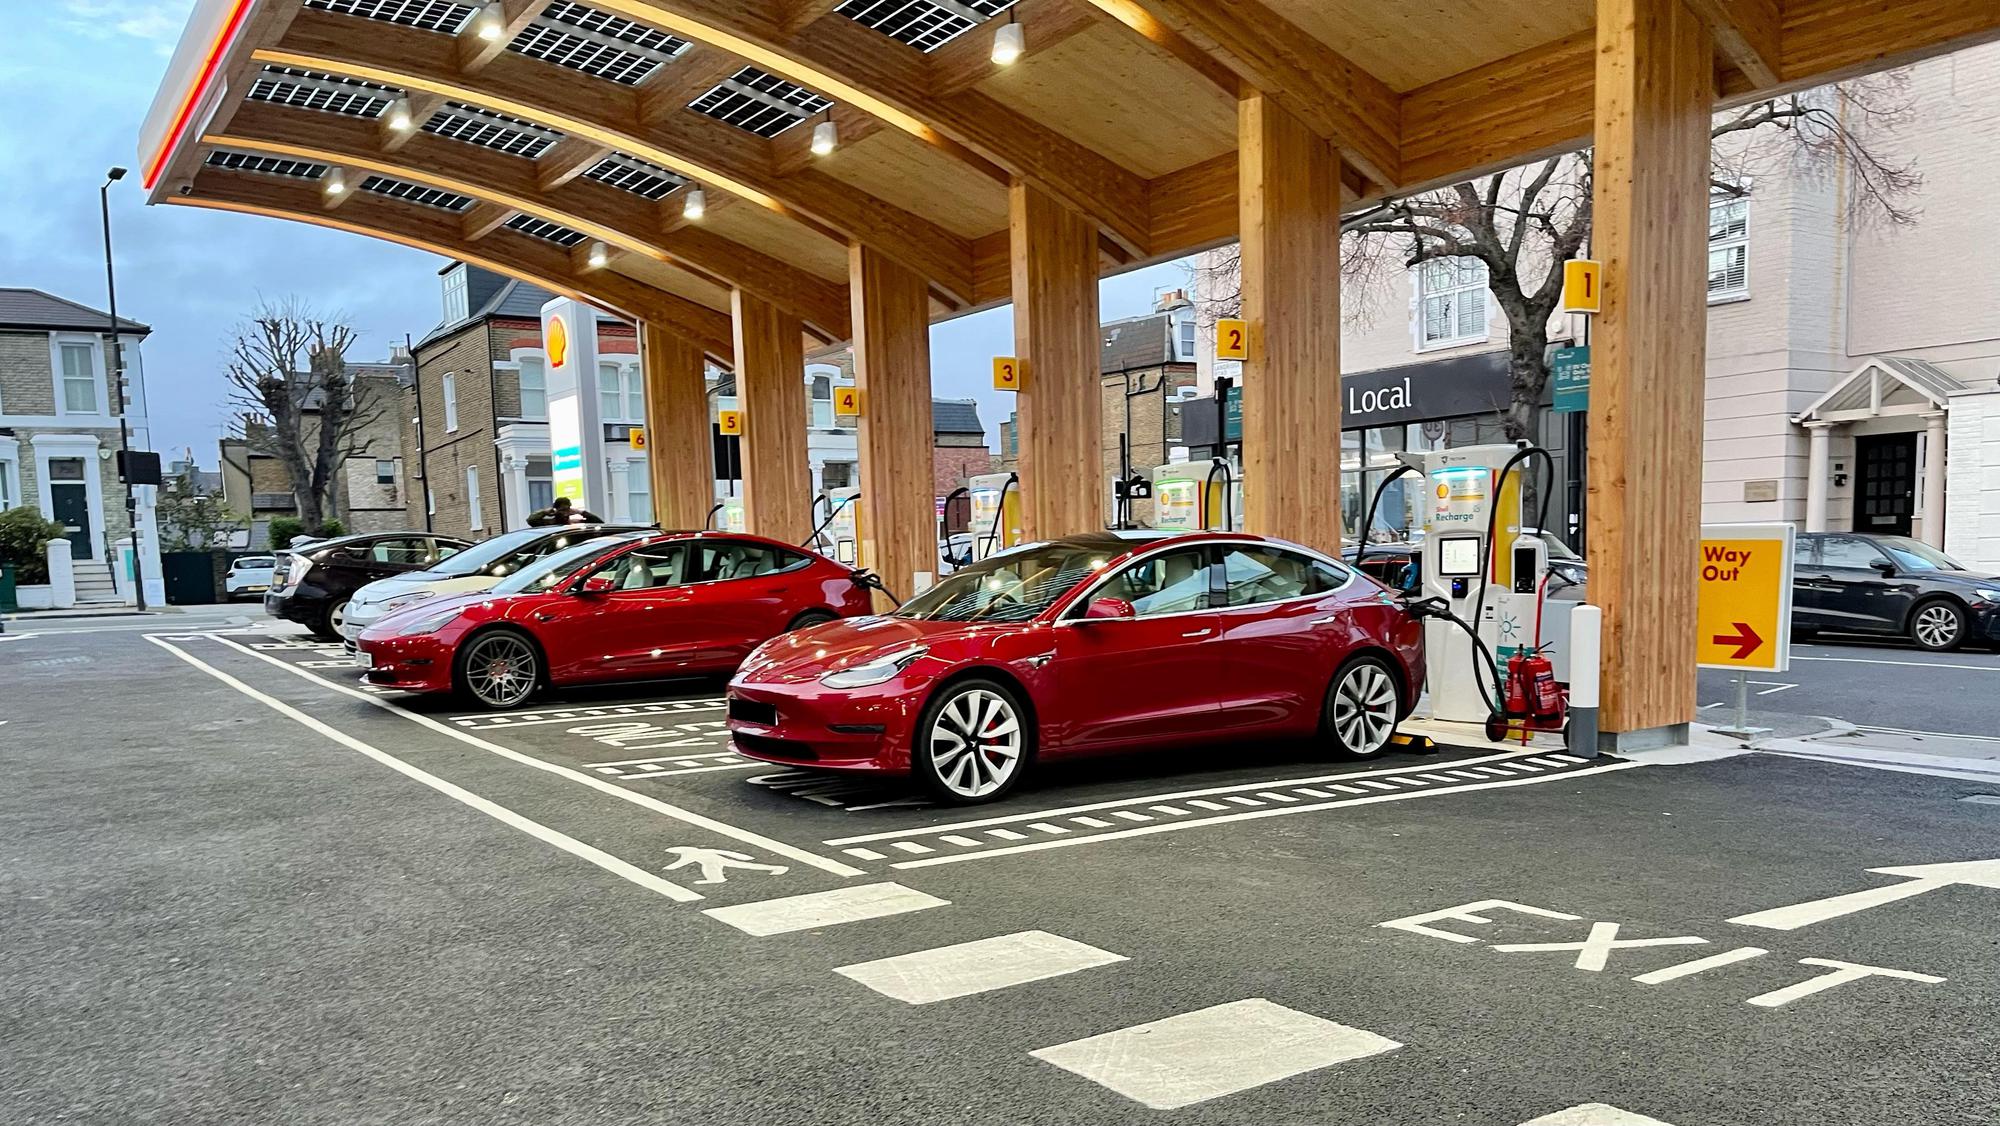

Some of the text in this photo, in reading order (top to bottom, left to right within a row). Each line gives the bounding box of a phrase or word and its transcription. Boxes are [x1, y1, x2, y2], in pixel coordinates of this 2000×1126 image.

[1584, 272, 1592, 298] 1
[1229, 329, 1241, 350] 2
[1002, 364, 1013, 382] 3
[843, 394, 854, 408] 4
[1349, 377, 1412, 414] Local
[727, 416, 736, 429] 5
[636, 433, 645, 445] 6
[1435, 512, 1474, 523] Recharge
[1703, 546, 1752, 567] Way
[1702, 565, 1739, 581] Out
[566, 722, 719, 750] ONLY
[1375, 899, 1946, 1007] EXIT
